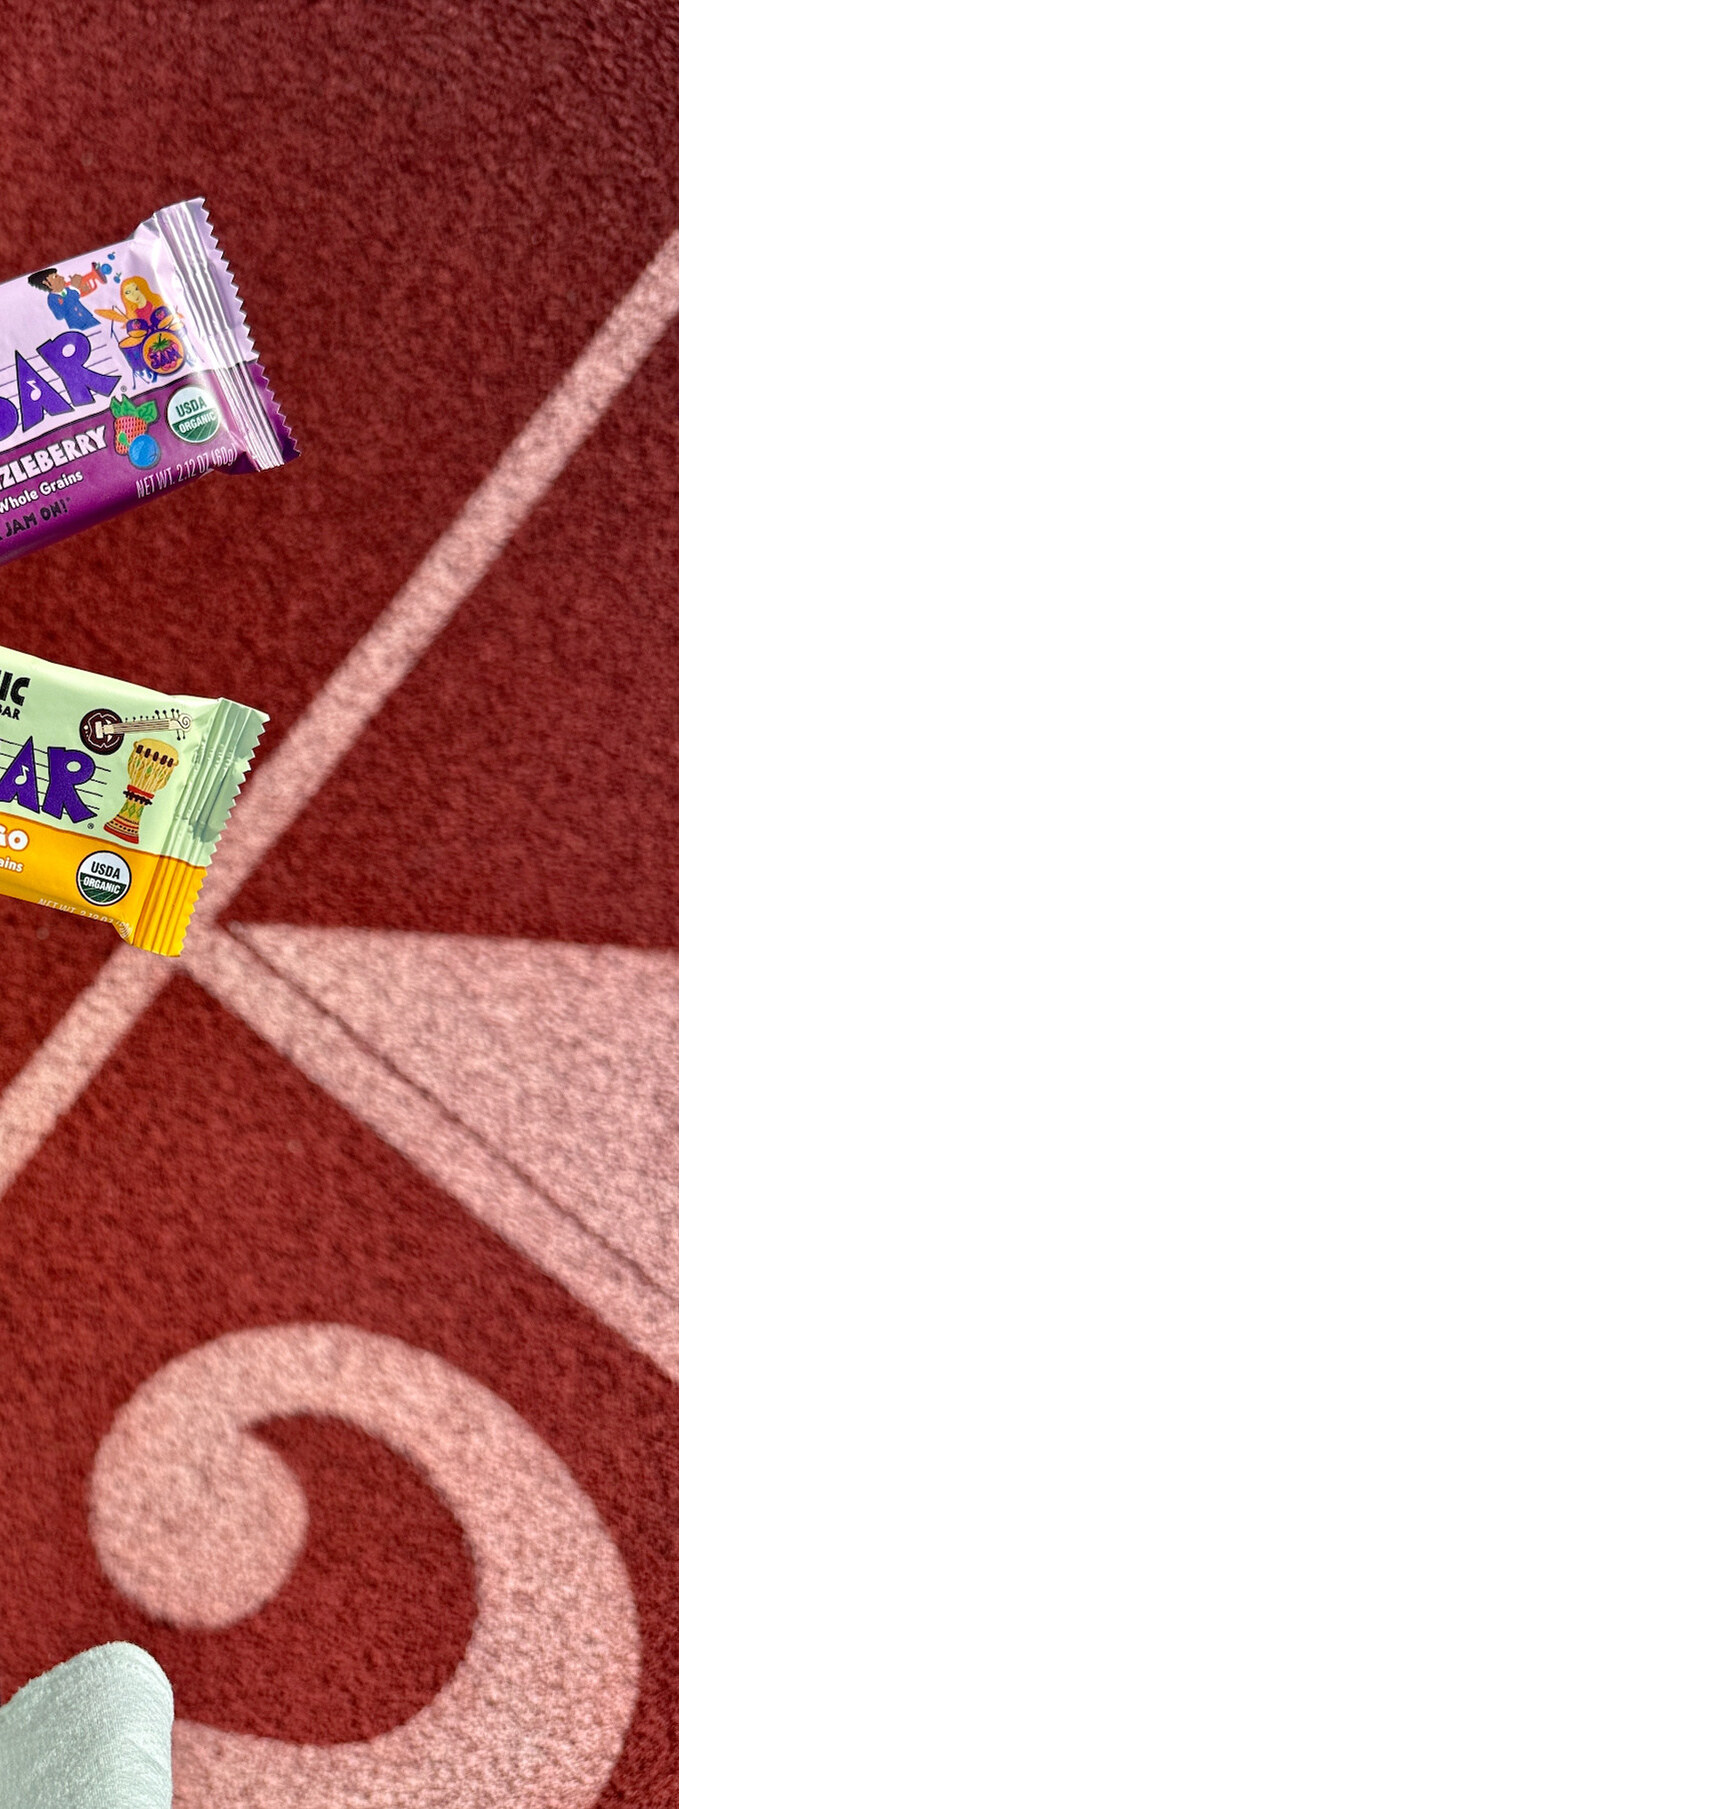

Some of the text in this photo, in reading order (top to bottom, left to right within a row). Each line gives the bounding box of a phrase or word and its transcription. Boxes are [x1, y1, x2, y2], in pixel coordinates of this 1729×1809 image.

[175, 395, 207, 418] USDA
[178, 411, 217, 434] ORGANIC
[39, 470, 84, 496] Grains
[136, 444, 238, 499] NET WT. 2.12 OZ (60g)
[5, 513, 38, 538] JAM
[91, 861, 120, 880] USDA
[83, 876, 121, 894] ORGANIC
